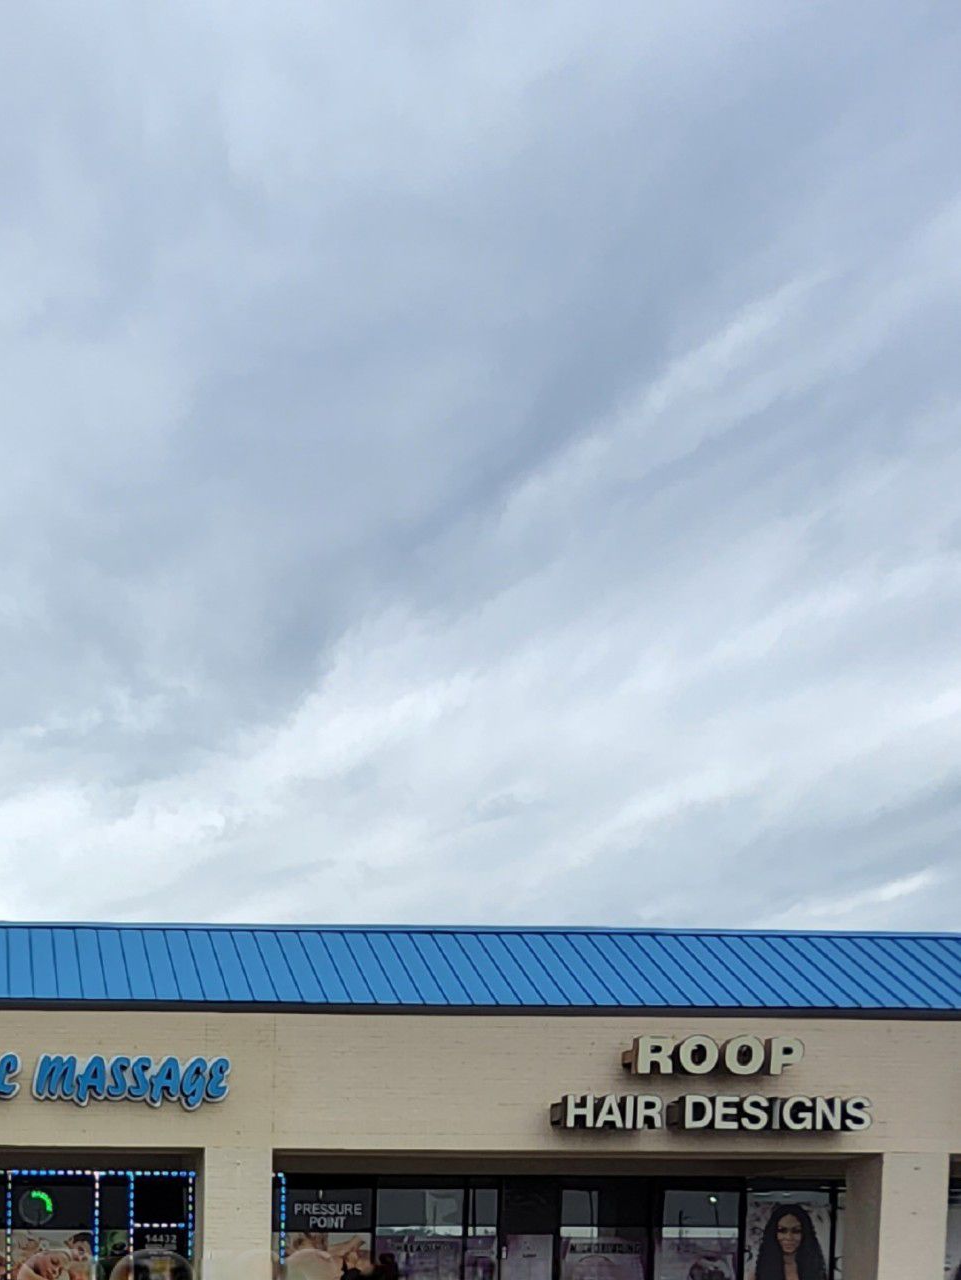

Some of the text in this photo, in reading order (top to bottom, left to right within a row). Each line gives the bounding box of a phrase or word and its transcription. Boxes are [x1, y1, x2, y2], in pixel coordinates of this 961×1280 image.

[633, 1034, 805, 1075] ROOP
[33, 1053, 231, 1112] MASSAGE
[565, 1094, 872, 1131] HAIR DESIGNS
[293, 1202, 363, 1216] PRESSURE
[309, 1215, 347, 1229] POINT
